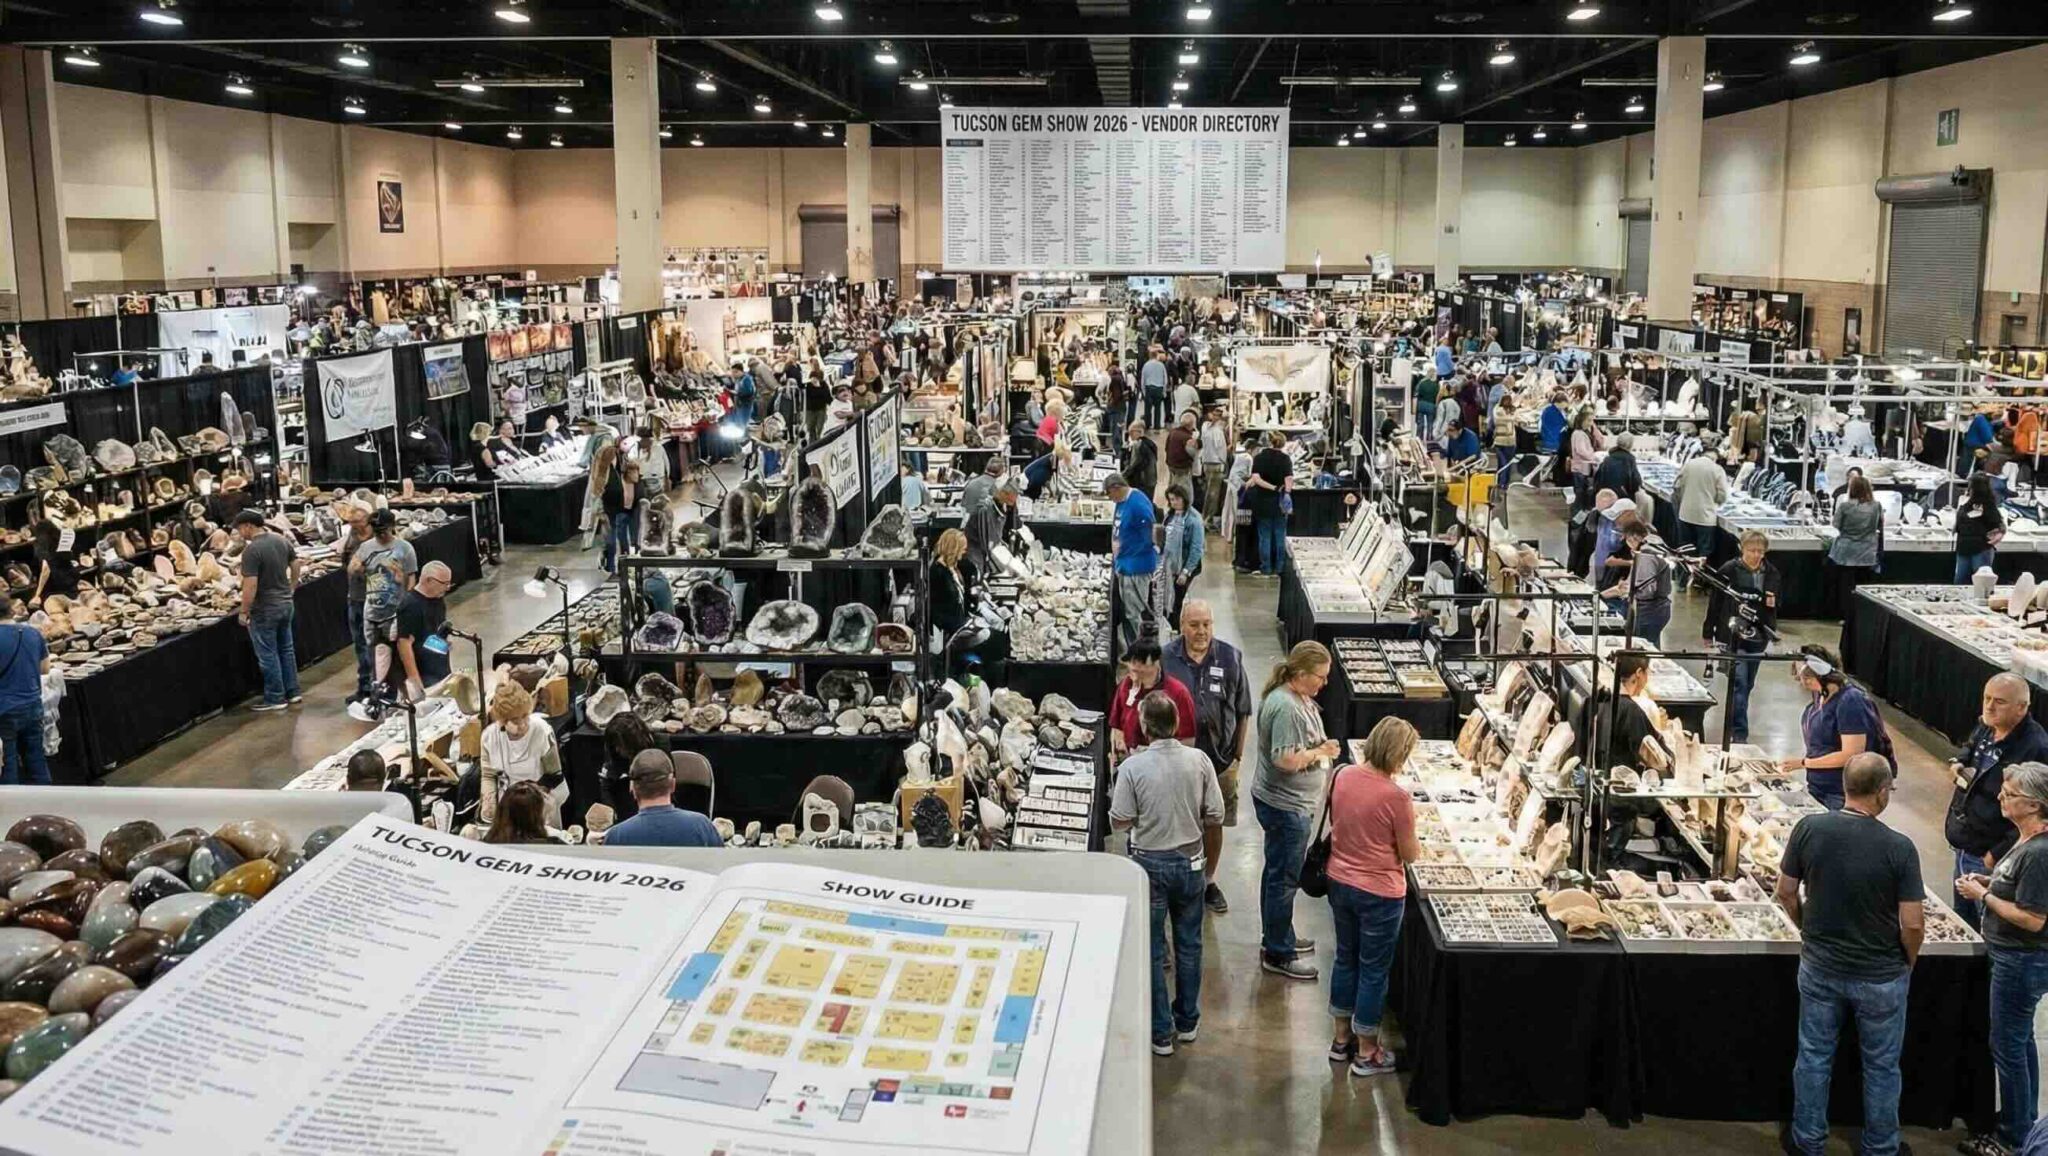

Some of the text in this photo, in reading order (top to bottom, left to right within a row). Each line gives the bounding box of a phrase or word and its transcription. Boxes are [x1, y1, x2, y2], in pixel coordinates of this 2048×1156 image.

[951, 113, 1008, 133] TUCSON
[1011, 113, 1043, 133] GEM
[1046, 113, 1089, 133] SHOW
[1093, 113, 1128, 133] 2026
[1142, 114, 1198, 133] VENDOR
[1203, 114, 1281, 133] DIRECTORY
[371, 826, 472, 863] TUCSON
[475, 856, 533, 876] GEM
[536, 866, 620, 884] SHOW
[621, 873, 687, 892] 2026
[821, 880, 975, 910] SHOW GUIDE
